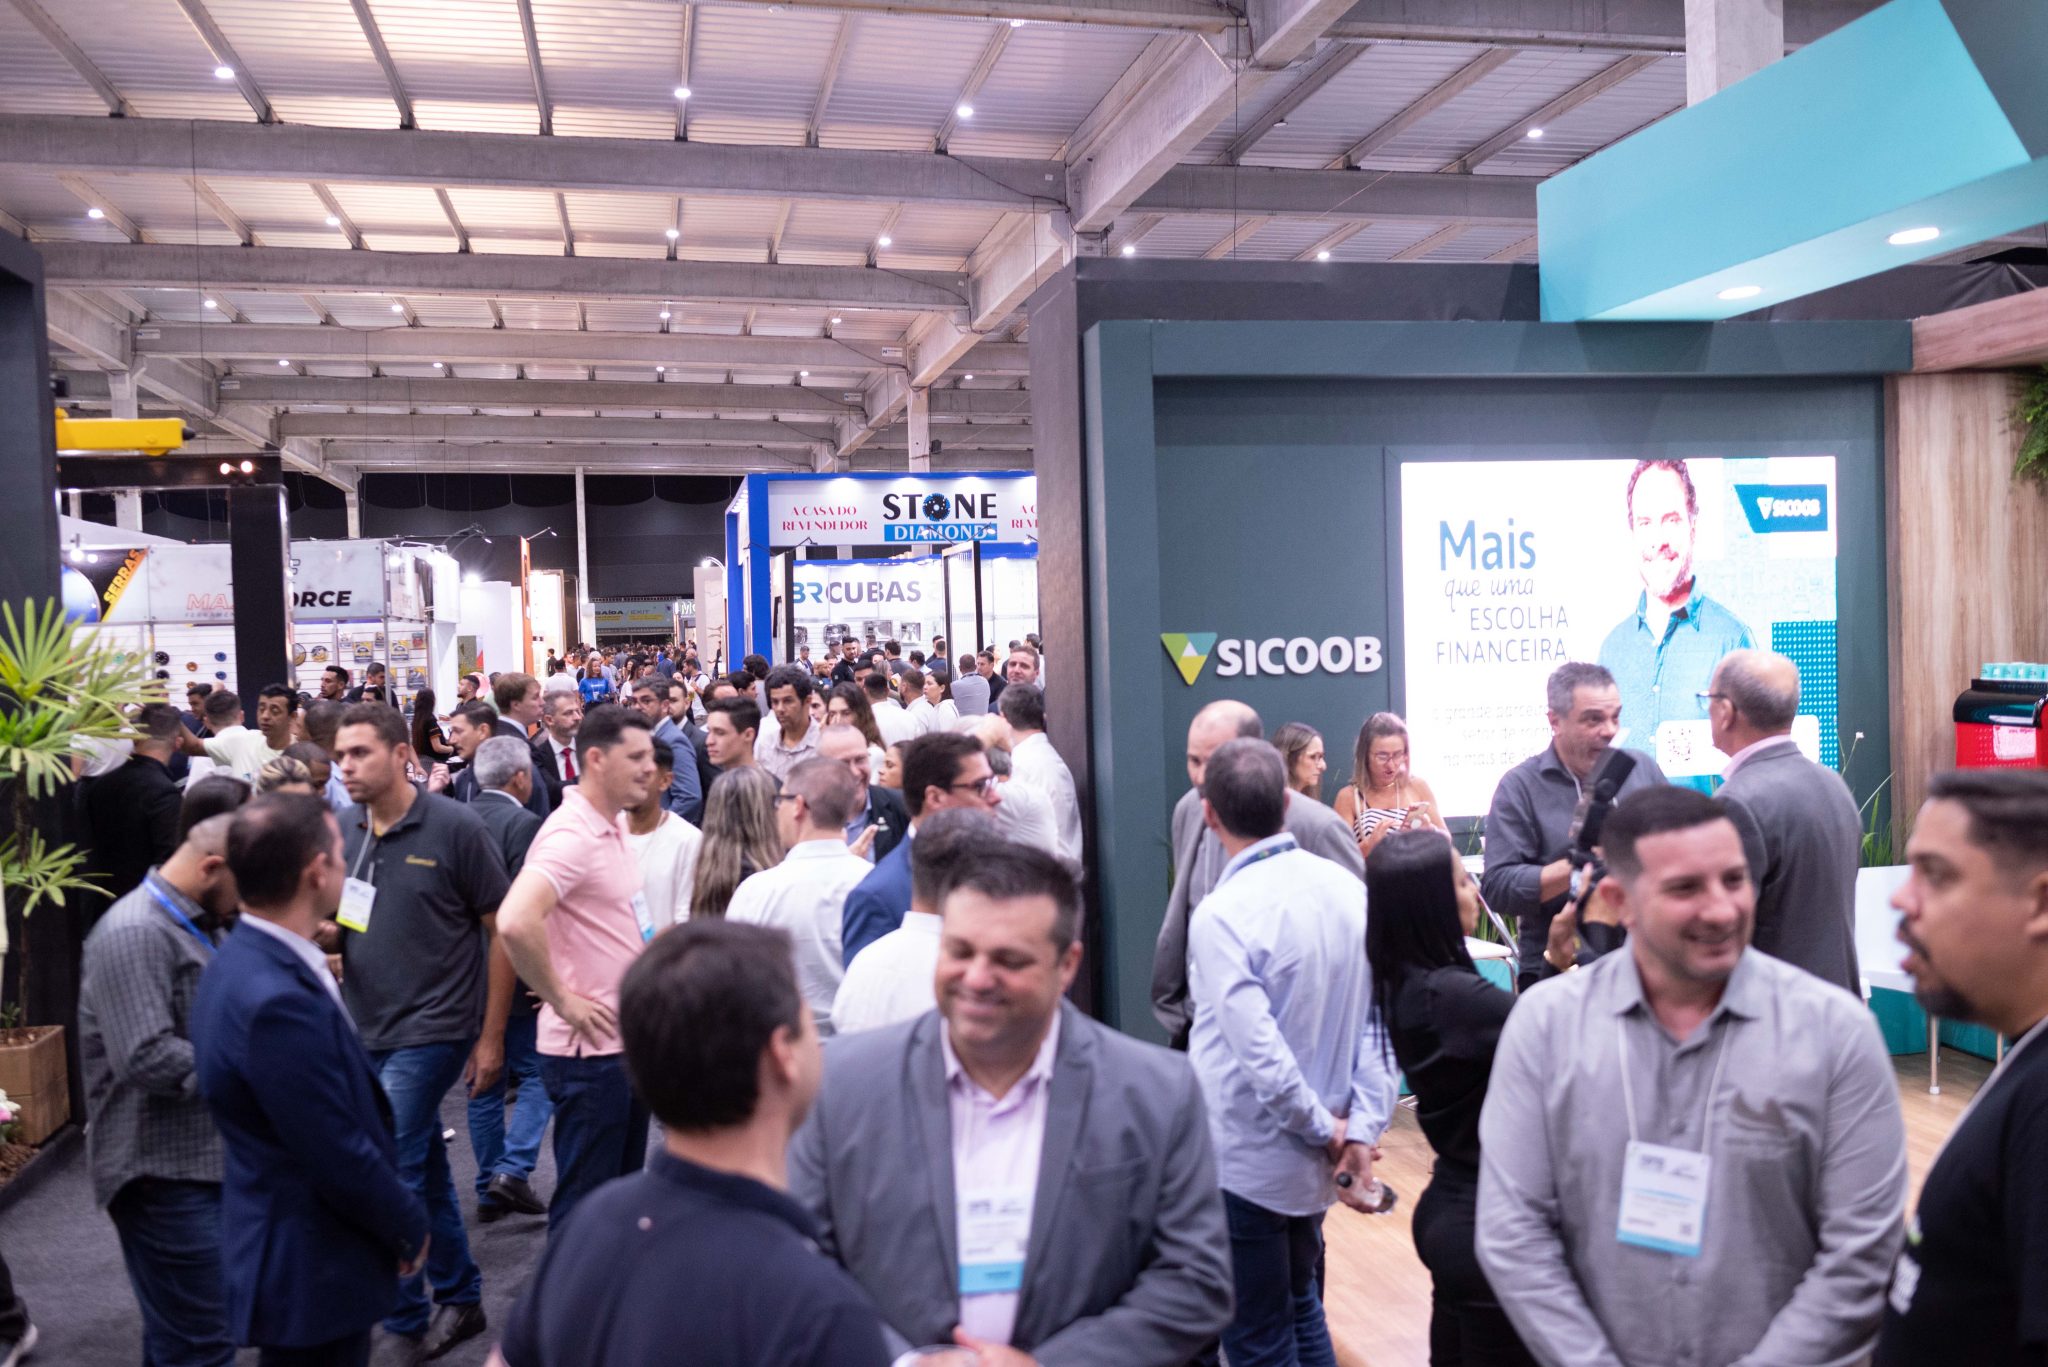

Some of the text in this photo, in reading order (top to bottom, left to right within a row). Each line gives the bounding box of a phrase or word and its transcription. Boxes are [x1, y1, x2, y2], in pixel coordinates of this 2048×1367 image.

[801, 506, 835, 516] CASA
[837, 506, 857, 516] DO
[782, 520, 868, 531] REVENDEDOR
[894, 525, 988, 541] DIAMOND
[1439, 518, 1536, 571] Mais
[1444, 577, 1534, 613] que uma
[1470, 605, 1569, 631] ESCOLHA
[1215, 635, 1383, 677] SICOOB
